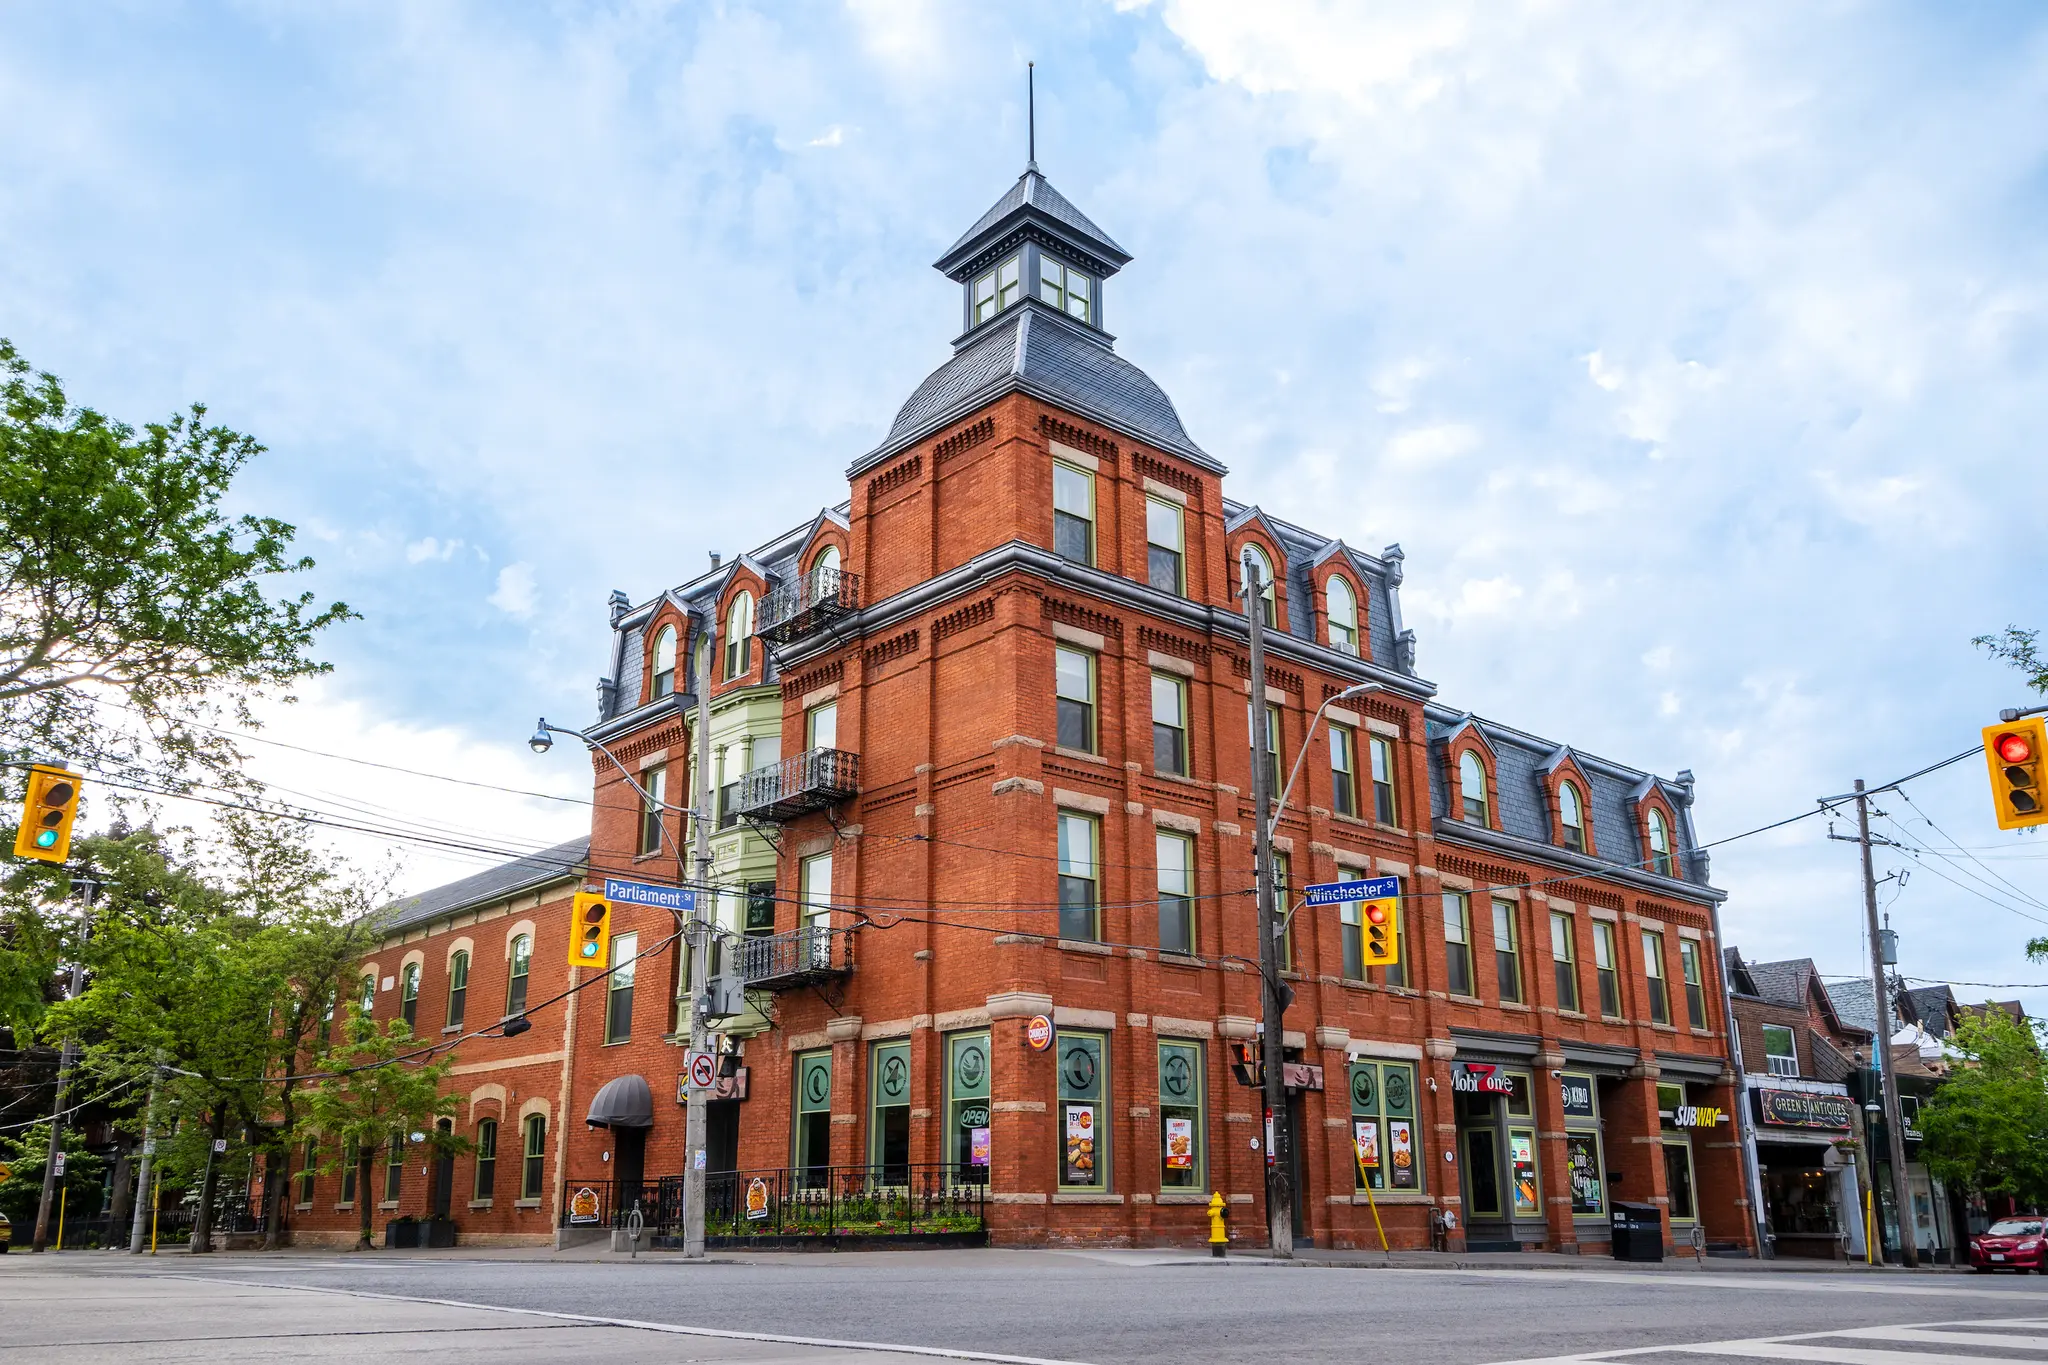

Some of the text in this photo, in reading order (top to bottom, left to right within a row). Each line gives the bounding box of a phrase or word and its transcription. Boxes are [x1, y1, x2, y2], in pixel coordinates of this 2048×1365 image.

[610, 882, 692, 906] Parliament St
[1309, 880, 1394, 903] Winchester St
[1571, 1086, 1588, 1103] KIBO
[1674, 1105, 1721, 1127] SUBWAY
[1810, 1101, 1847, 1116] ANTIQUES
[962, 1109, 989, 1125] OPEN
[1069, 1112, 1080, 1122] TEX
[1904, 1116, 1911, 1126] 99
